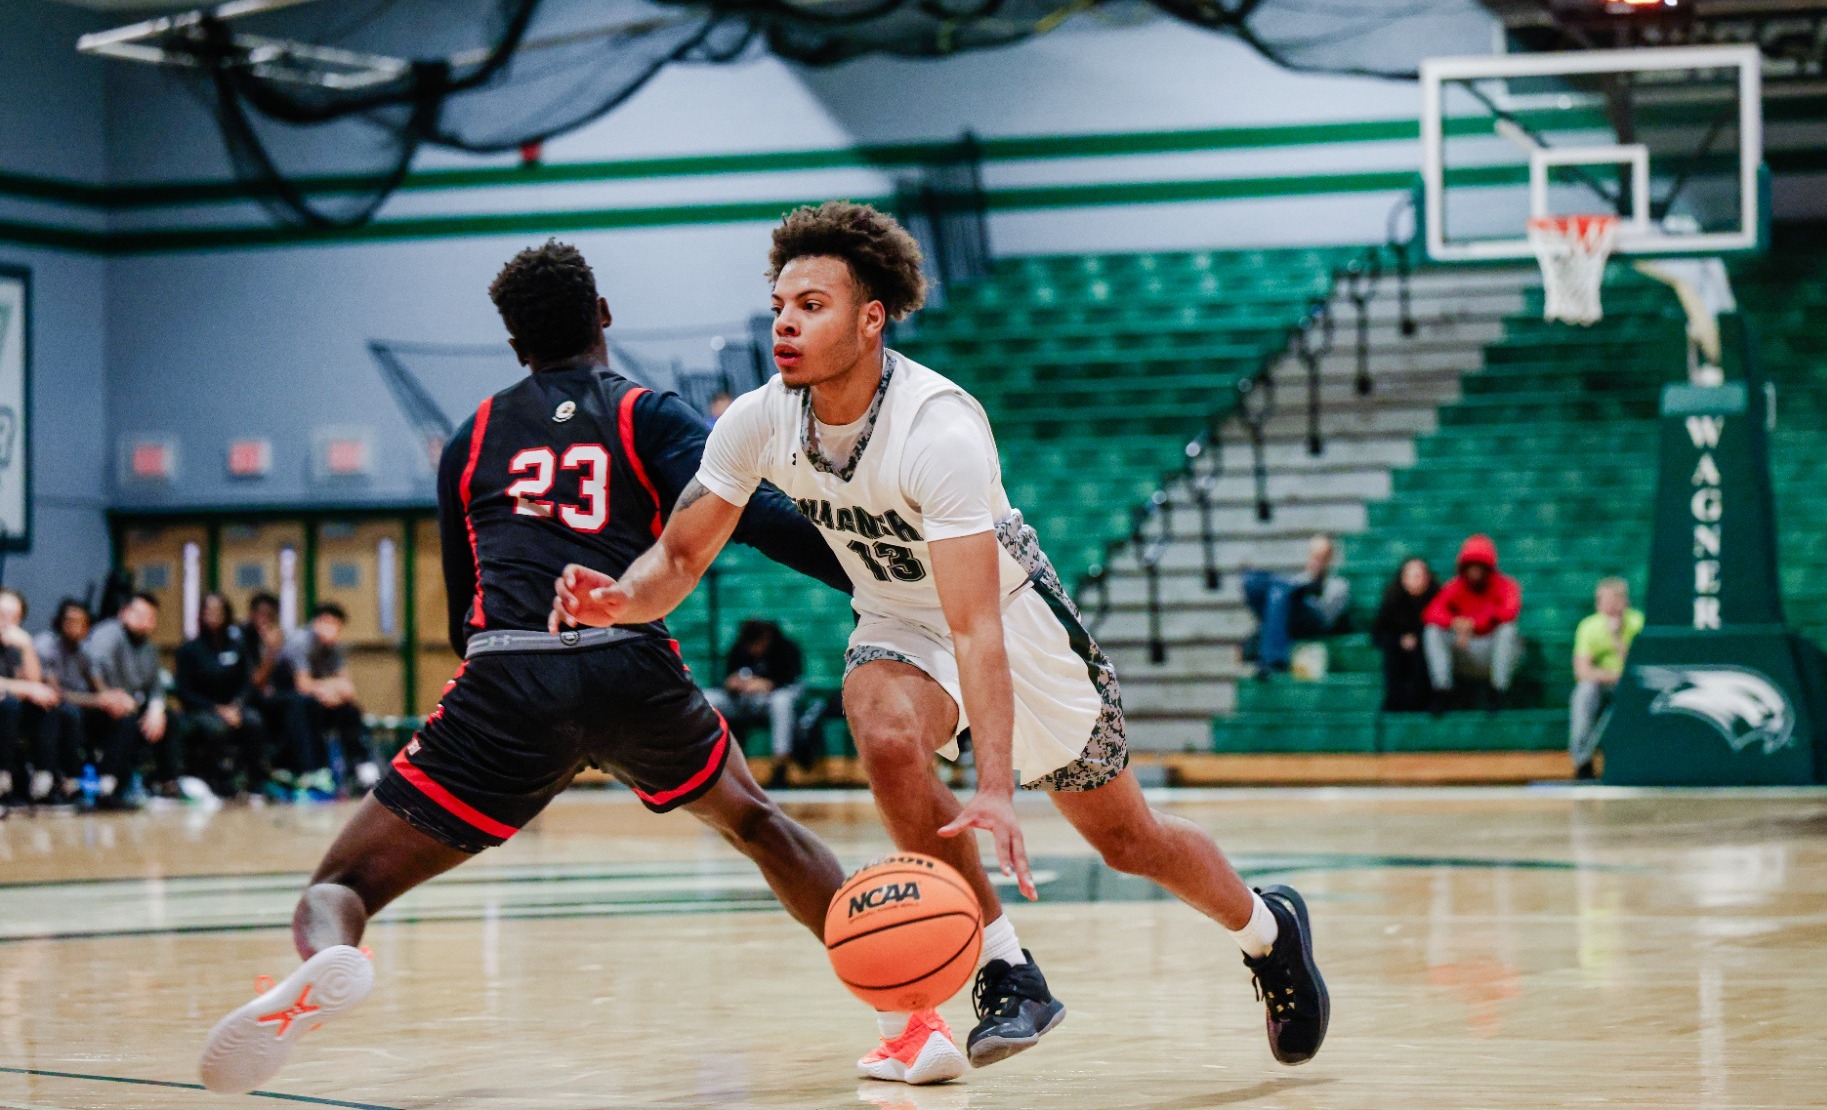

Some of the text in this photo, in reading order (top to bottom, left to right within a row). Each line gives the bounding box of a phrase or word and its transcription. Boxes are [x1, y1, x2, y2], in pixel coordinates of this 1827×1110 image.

[505, 443, 611, 534] 23
[1686, 415, 1725, 630] WAGNER
[846, 539, 926, 582] 13
[848, 881, 921, 918] NCAA
